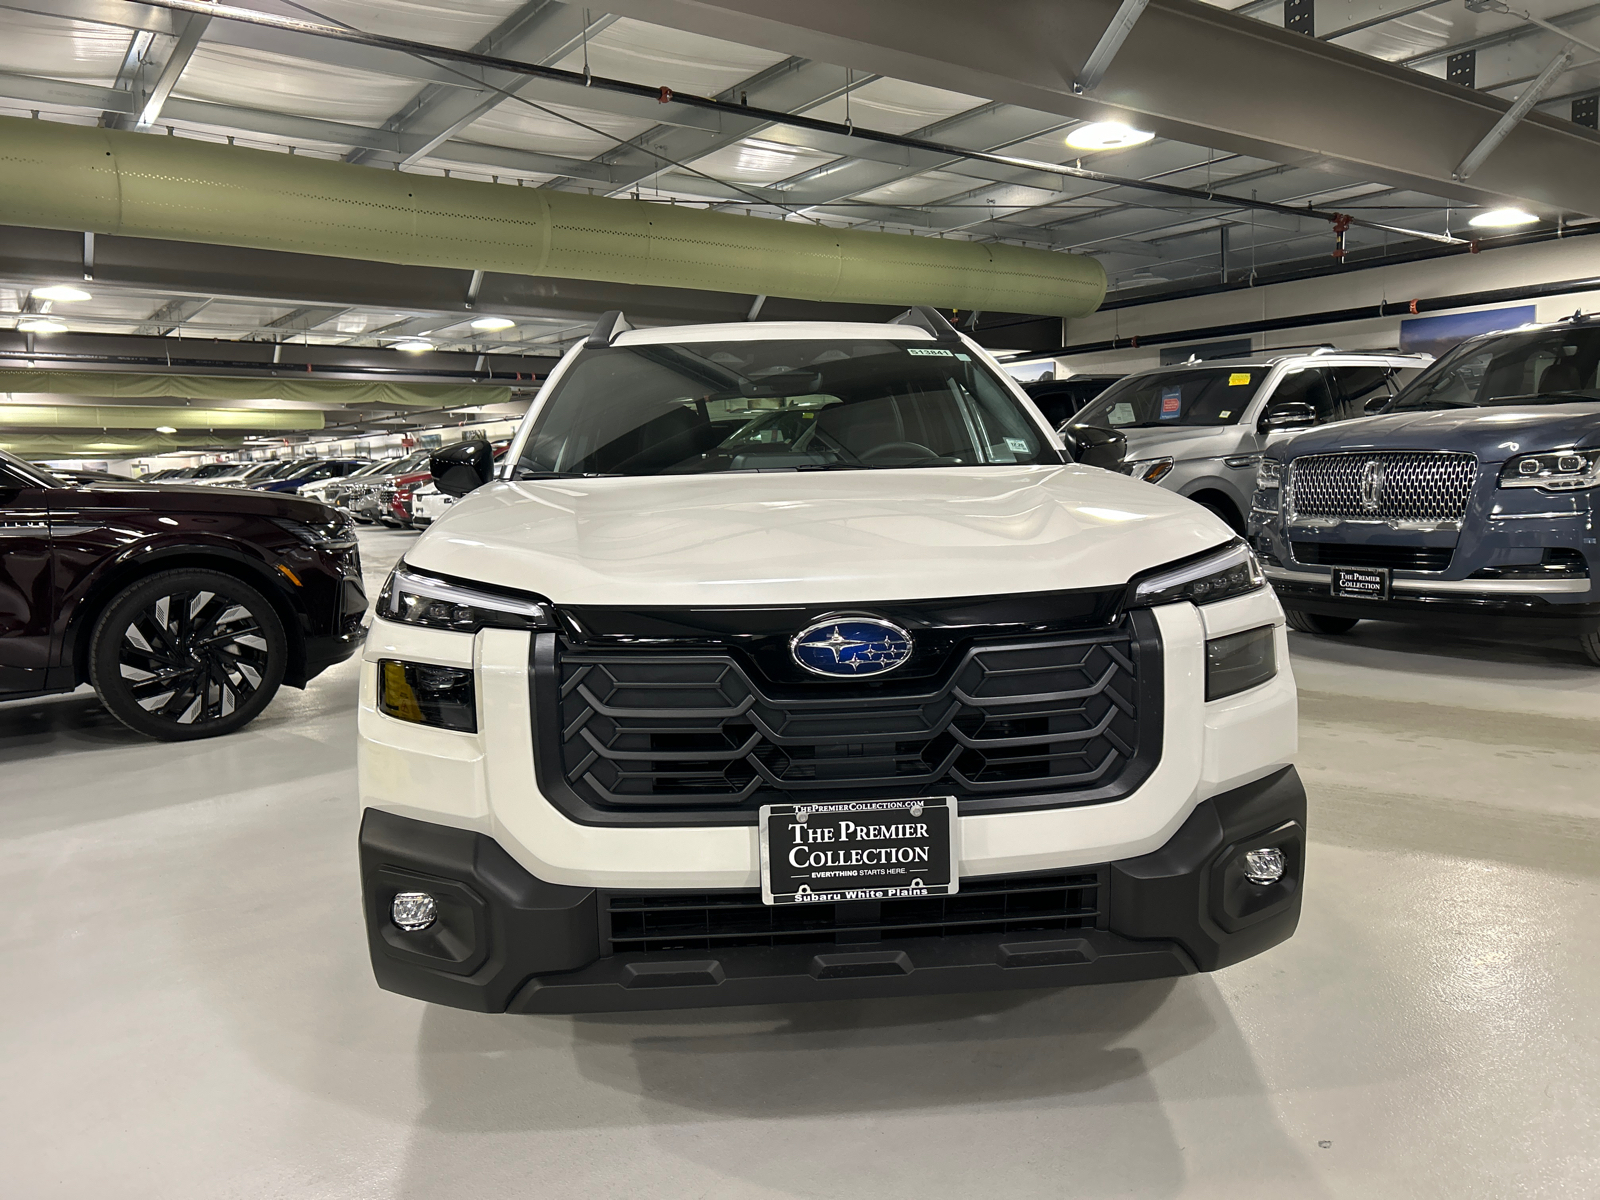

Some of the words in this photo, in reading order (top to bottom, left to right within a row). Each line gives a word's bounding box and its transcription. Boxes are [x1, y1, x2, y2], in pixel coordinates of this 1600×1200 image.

[1340, 572, 1353, 580] THE
[1354, 573, 1380, 582] PREMIER
[1340, 580, 1380, 590] COLLECTION
[788, 823, 835, 844] THE
[838, 820, 930, 842] PREMIER
[788, 846, 930, 868] COLLECTION
[811, 869, 858, 879] EVERYTHING
[859, 868, 886, 876] STARTS
[886, 867, 908, 875] HERE.
[794, 892, 841, 902] Subaru
[845, 889, 884, 900] White
[888, 887, 928, 898] Plains
